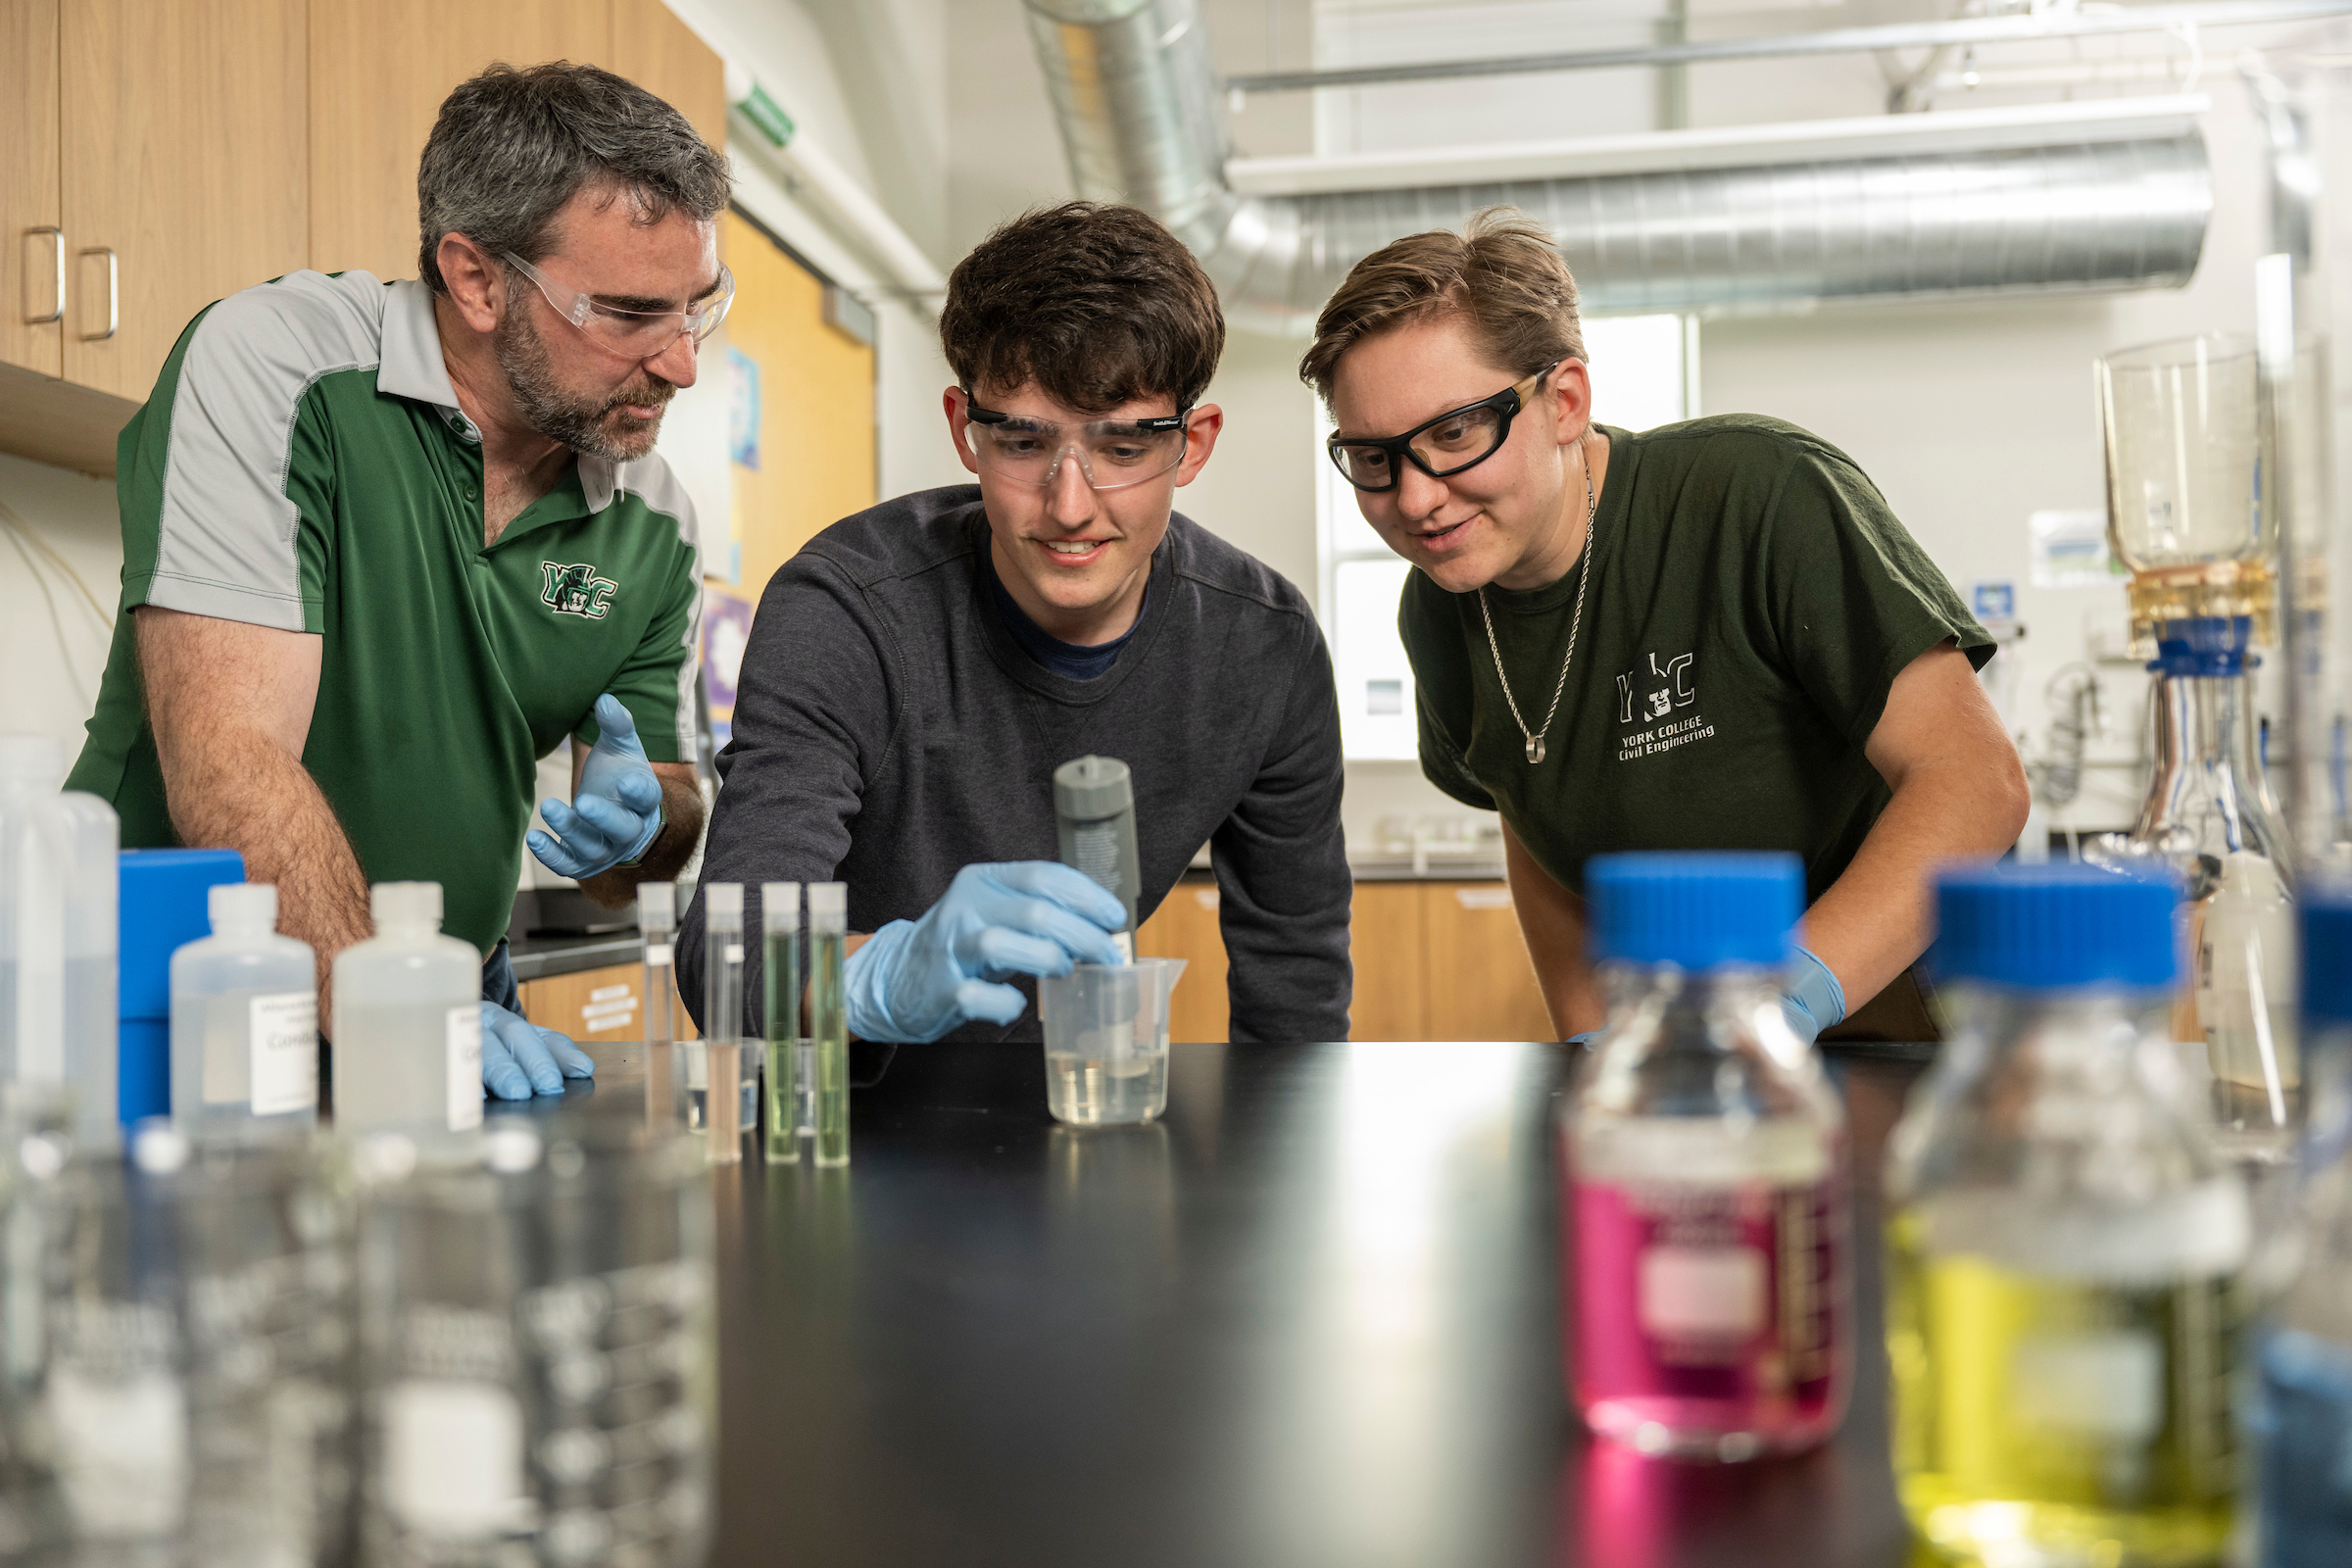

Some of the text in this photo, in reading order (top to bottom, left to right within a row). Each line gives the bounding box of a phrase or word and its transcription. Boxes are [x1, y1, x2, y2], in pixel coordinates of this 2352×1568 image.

[1619, 725, 1715, 761] Civil Engineering
[1622, 715, 1703, 748] YORK COLLEGE
